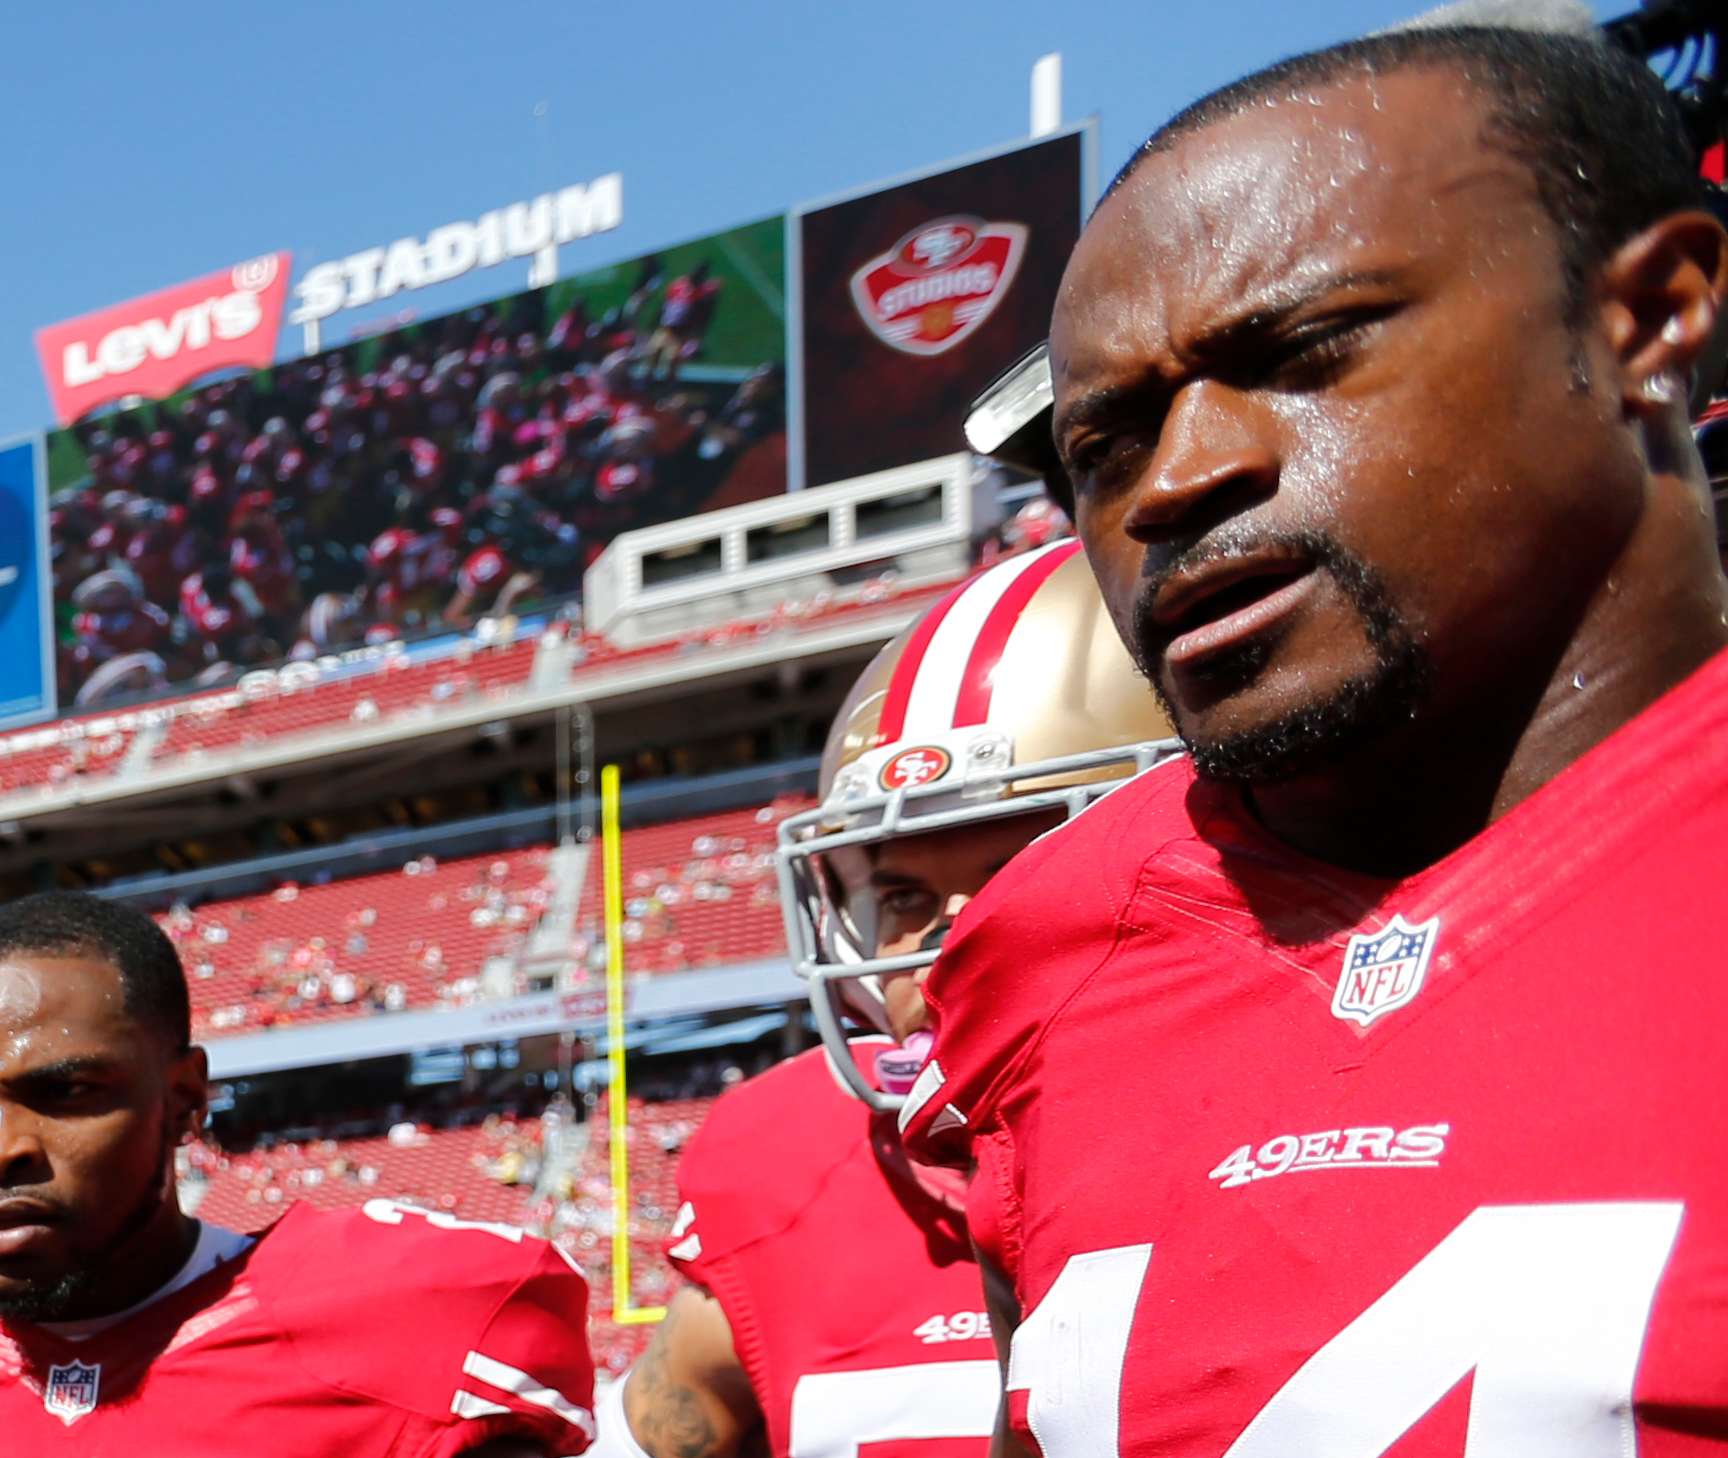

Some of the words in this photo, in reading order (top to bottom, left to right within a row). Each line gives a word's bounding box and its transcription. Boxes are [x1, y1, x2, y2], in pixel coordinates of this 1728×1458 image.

[288, 171, 624, 324] STADIUM
[876, 261, 999, 321] STUDIOS
[1346, 963, 1406, 1005] NFL
[1208, 1122, 1450, 1189] 49ERS
[54, 1384, 91, 1409] NFL
